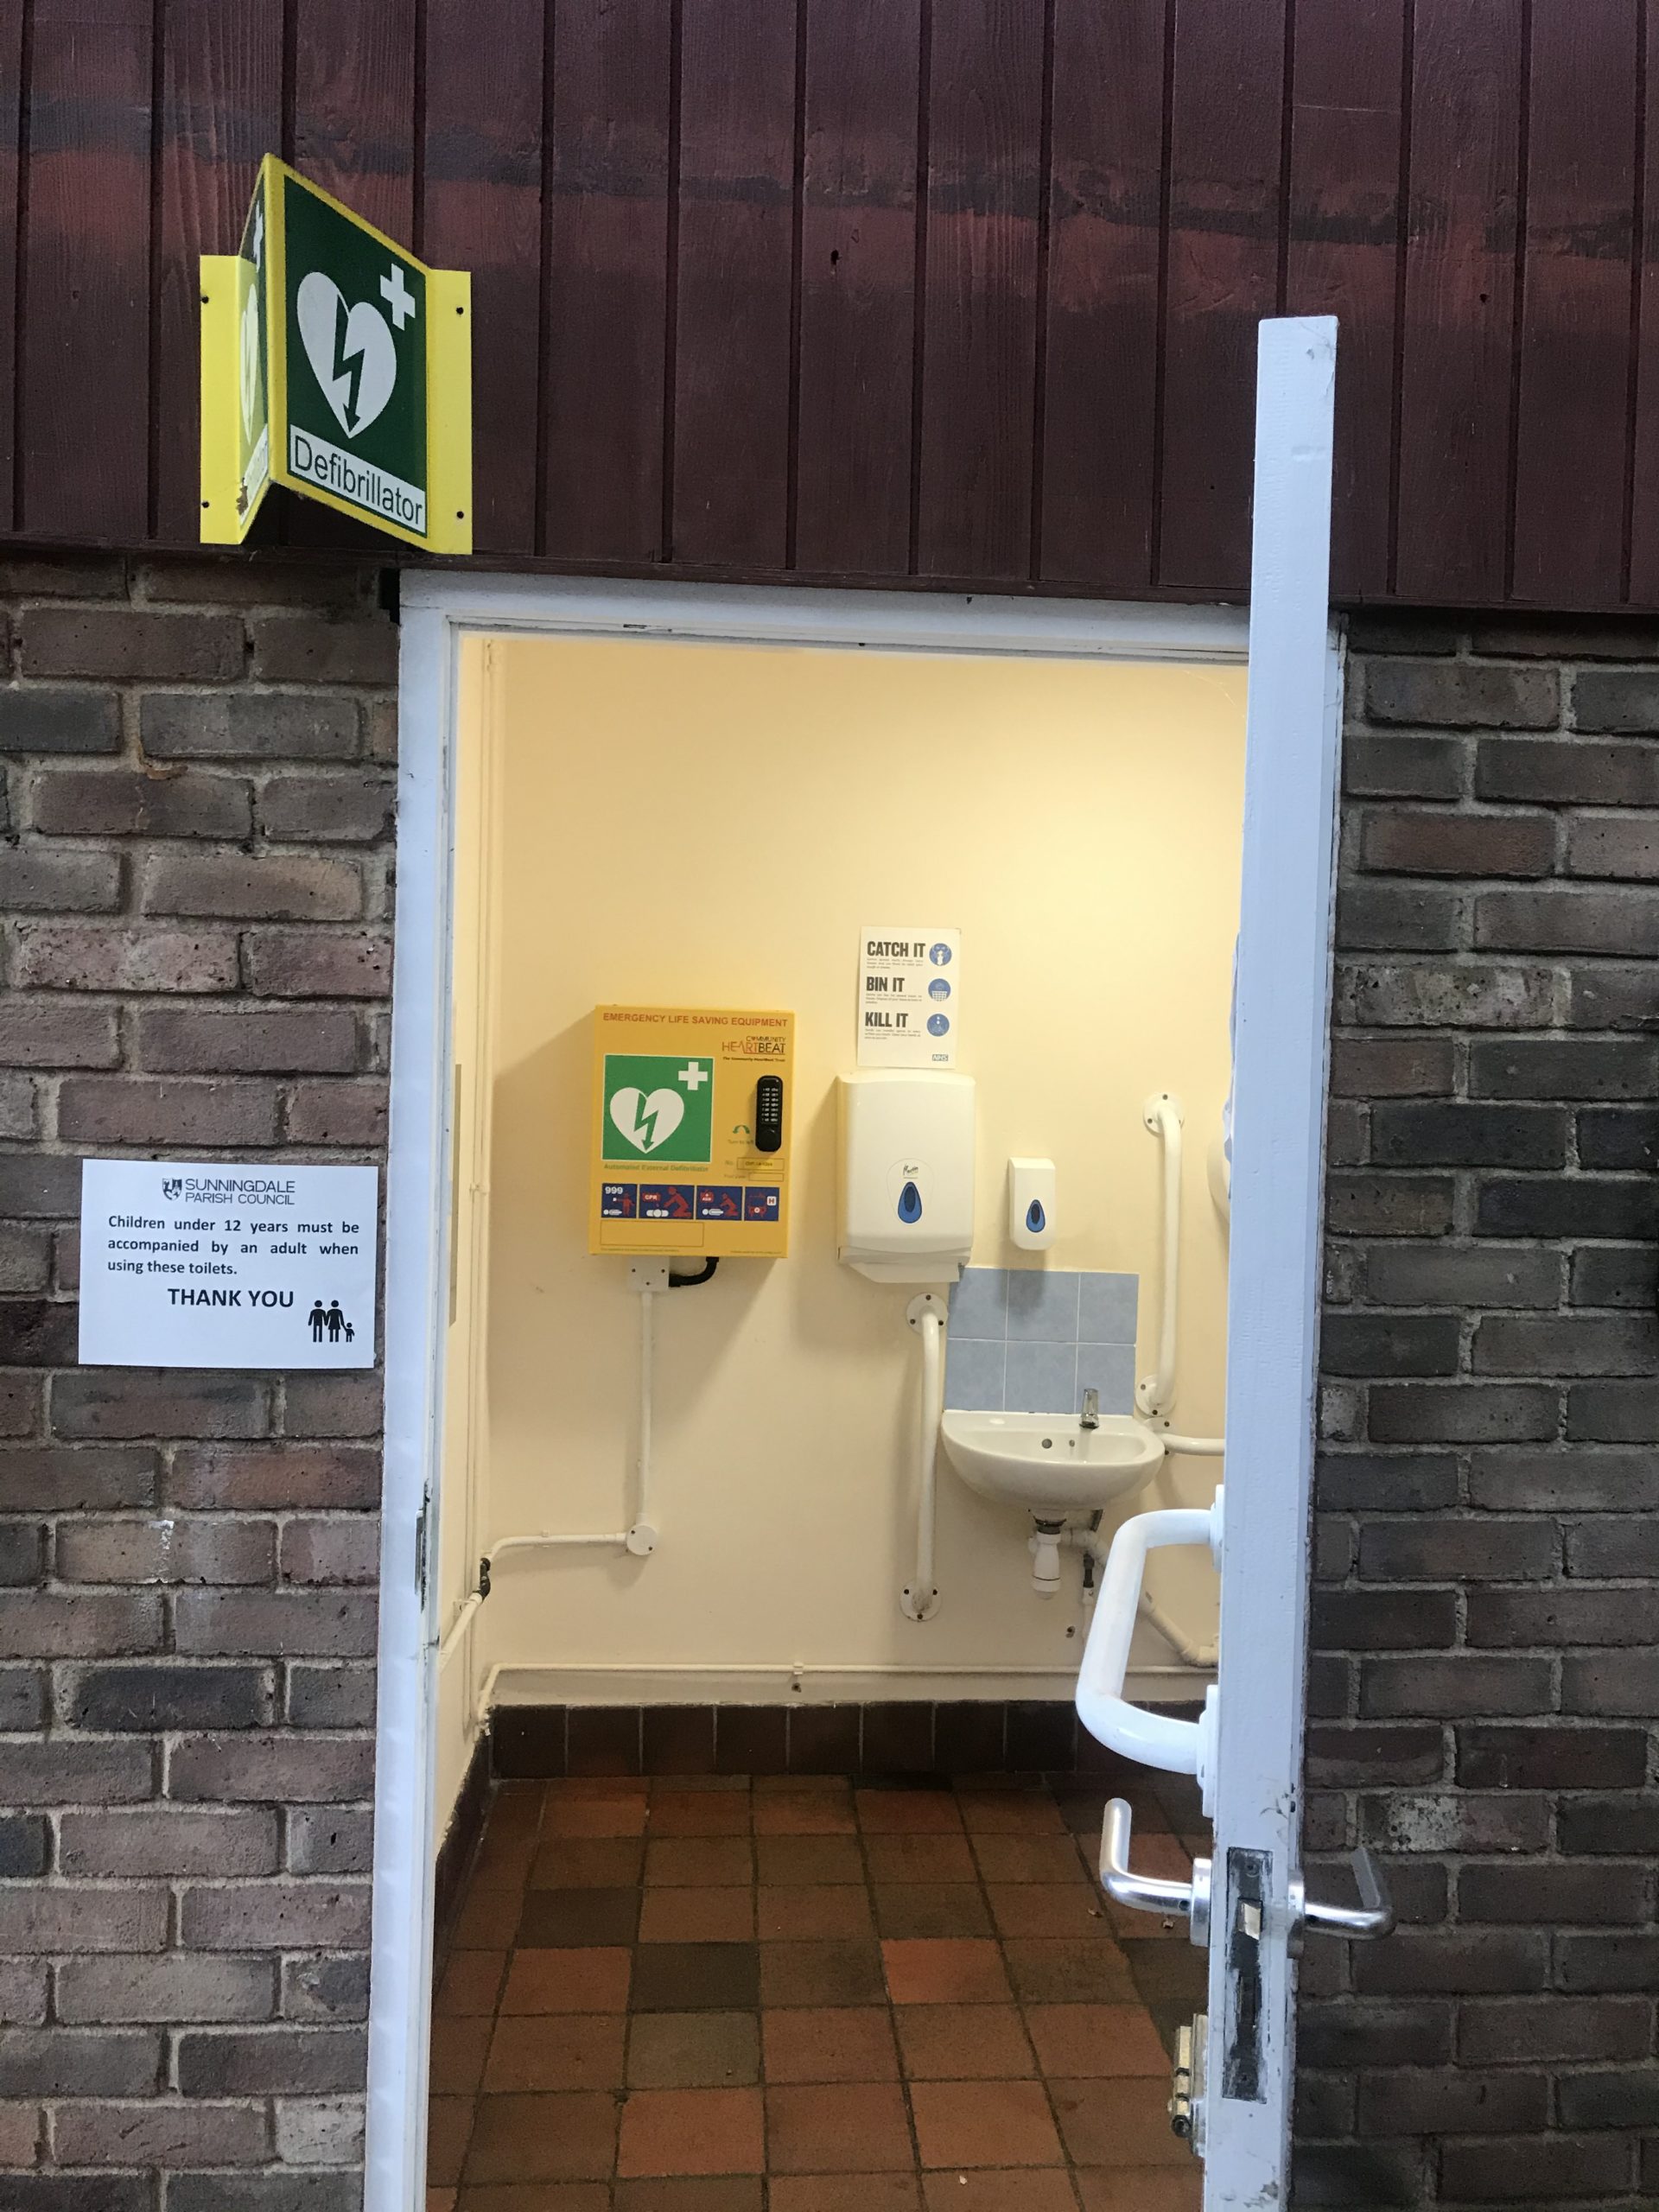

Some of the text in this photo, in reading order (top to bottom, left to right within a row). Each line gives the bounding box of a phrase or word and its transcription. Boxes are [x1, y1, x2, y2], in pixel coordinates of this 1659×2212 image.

[295, 434, 423, 525] Defibrillator
[867, 940, 925, 957] CATCH IT
[866, 976, 905, 992] BIN IT
[603, 1012, 788, 1027] EMERGENCY LIFE SAVING EQUIPMENT
[865, 1011, 908, 1027] KILL IT
[185, 1179, 296, 1193] SUNNINGDALE
[605, 1185, 623, 1194] 999
[185, 1192, 296, 1205] PARISH COUNCIL
[109, 1215, 359, 1235] Children under 12 years must be
[108, 1239, 359, 1255] accompanied by an adult when
[107, 1260, 238, 1274] using these toilets.
[168, 1288, 294, 1307] THANK YOU
